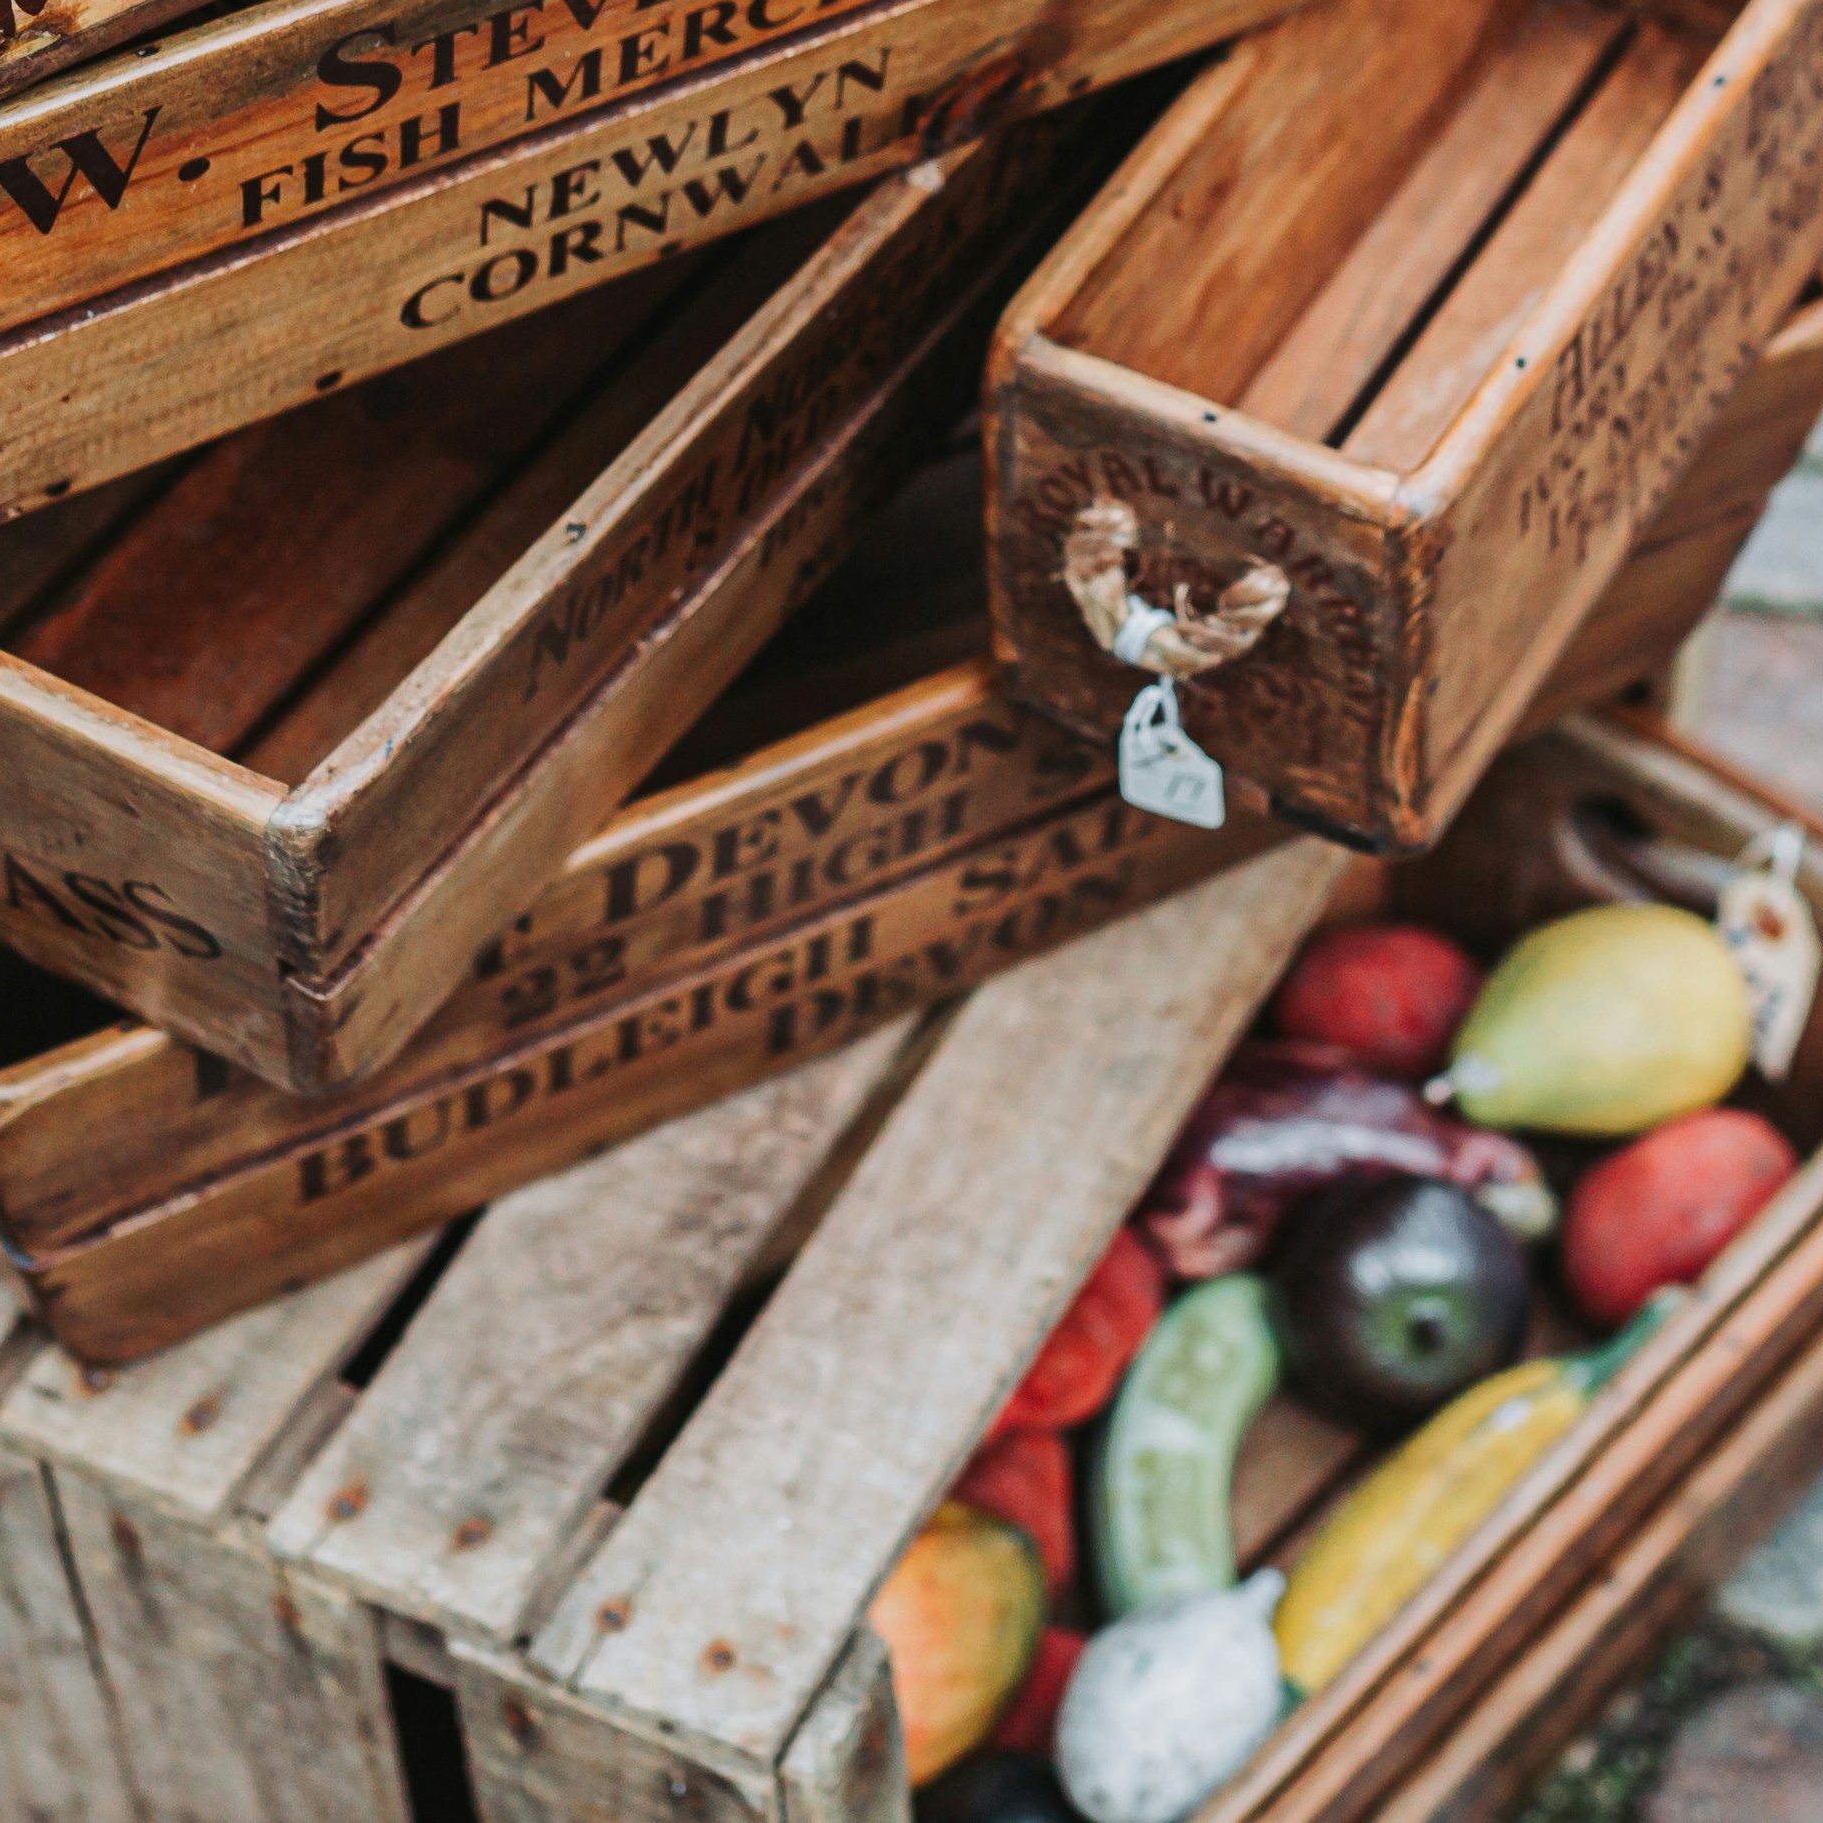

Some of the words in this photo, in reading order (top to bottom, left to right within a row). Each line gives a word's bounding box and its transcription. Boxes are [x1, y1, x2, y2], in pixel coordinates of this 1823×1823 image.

[241, 98, 463, 229] FISH
[477, 47, 894, 248] NEWLYN
[602, 715, 1021, 925] DEVON
[696, 787, 973, 944] HIGH
[296, 916, 882, 1204] BUDLEIGH
